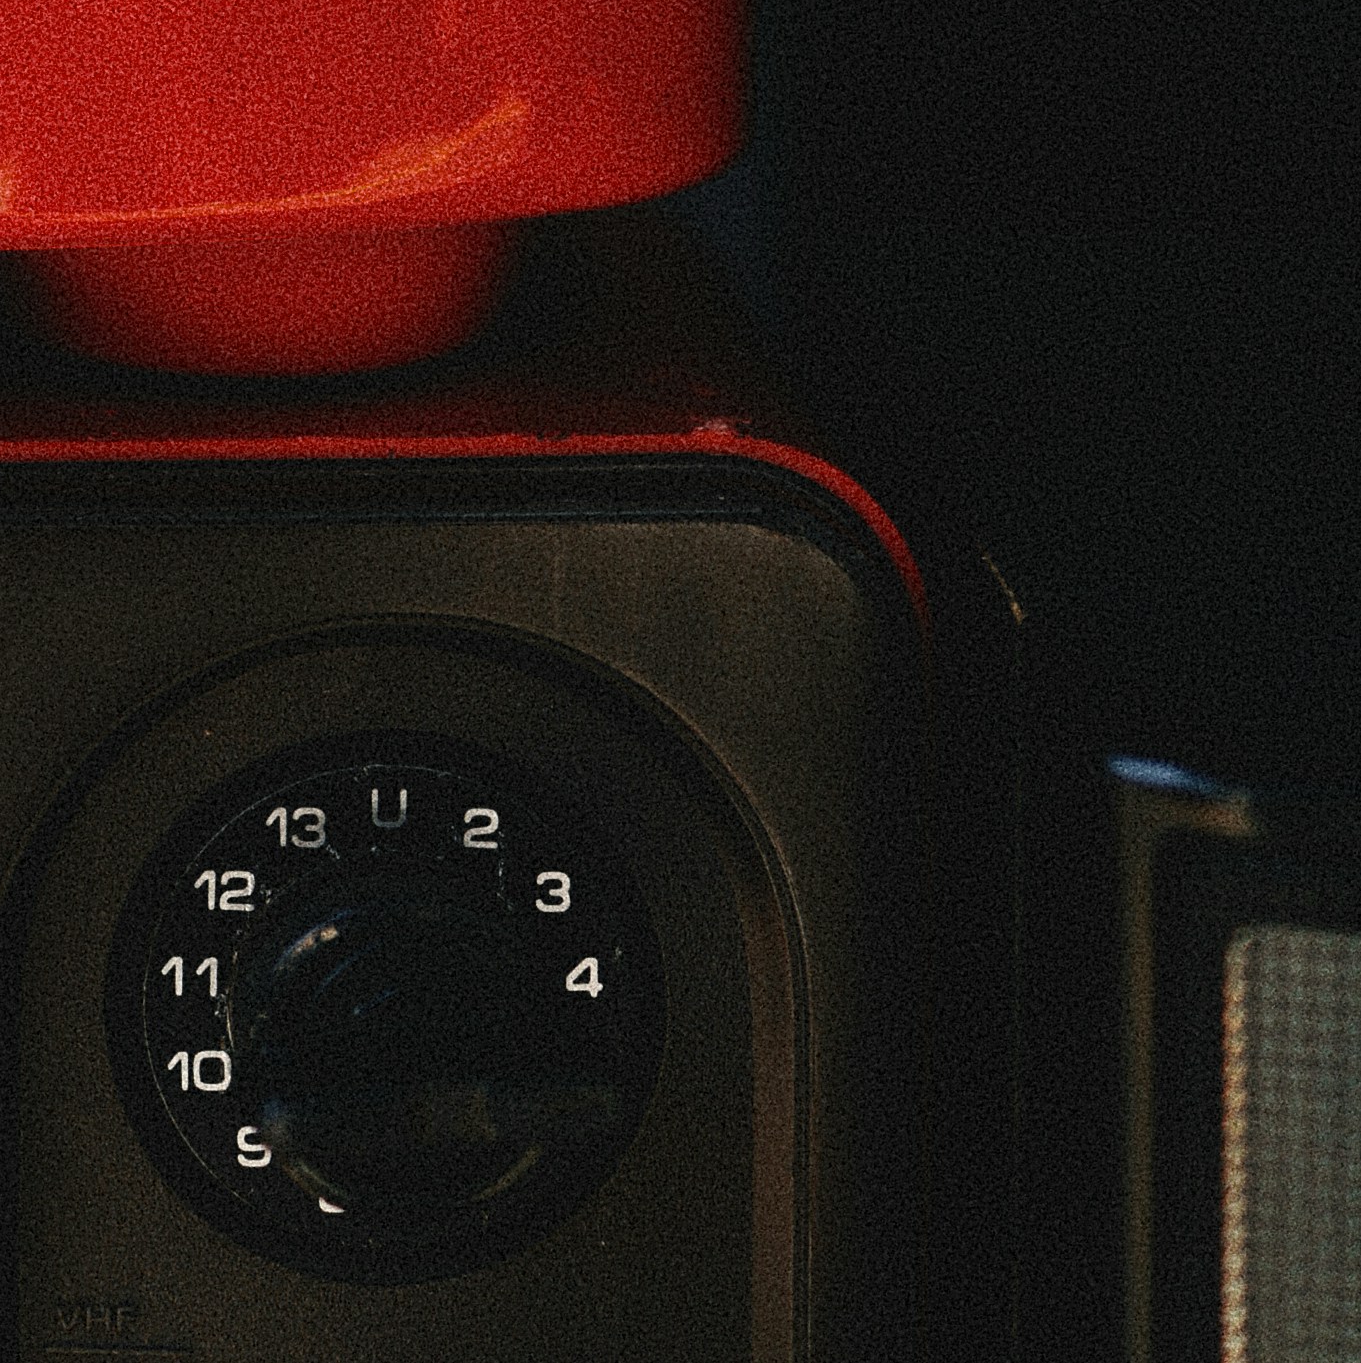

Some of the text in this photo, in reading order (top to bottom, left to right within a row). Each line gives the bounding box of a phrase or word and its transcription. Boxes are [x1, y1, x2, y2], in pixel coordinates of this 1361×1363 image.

[266, 806, 326, 848] 13
[371, 788, 407, 827] U
[463, 808, 498, 849] 2
[194, 869, 256, 911] 12
[535, 871, 570, 912] 3
[161, 956, 217, 996] 11
[565, 957, 603, 997] 4
[168, 1051, 231, 1091] 10
